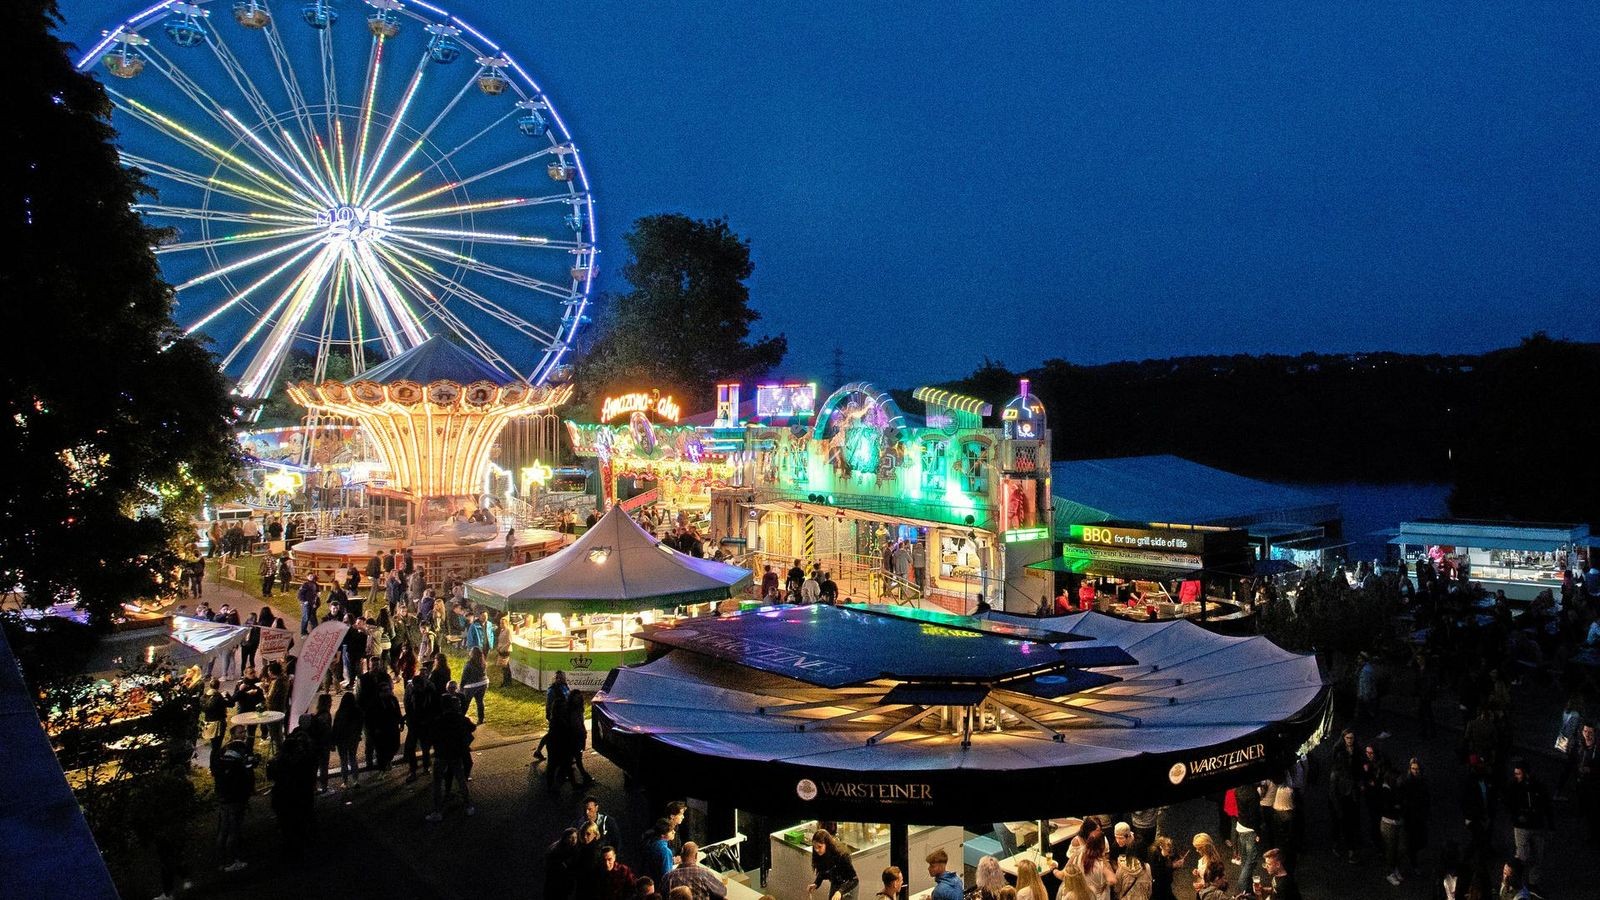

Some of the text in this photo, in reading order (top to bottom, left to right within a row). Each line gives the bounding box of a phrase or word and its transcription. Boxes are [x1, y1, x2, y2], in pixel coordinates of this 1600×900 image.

[316, 206, 392, 230] MOVIE
[1083, 527, 1188, 549] BBQ for the grill side of life
[1189, 743, 1265, 774] WARSTEINER
[821, 781, 933, 799] WARSTEINER
